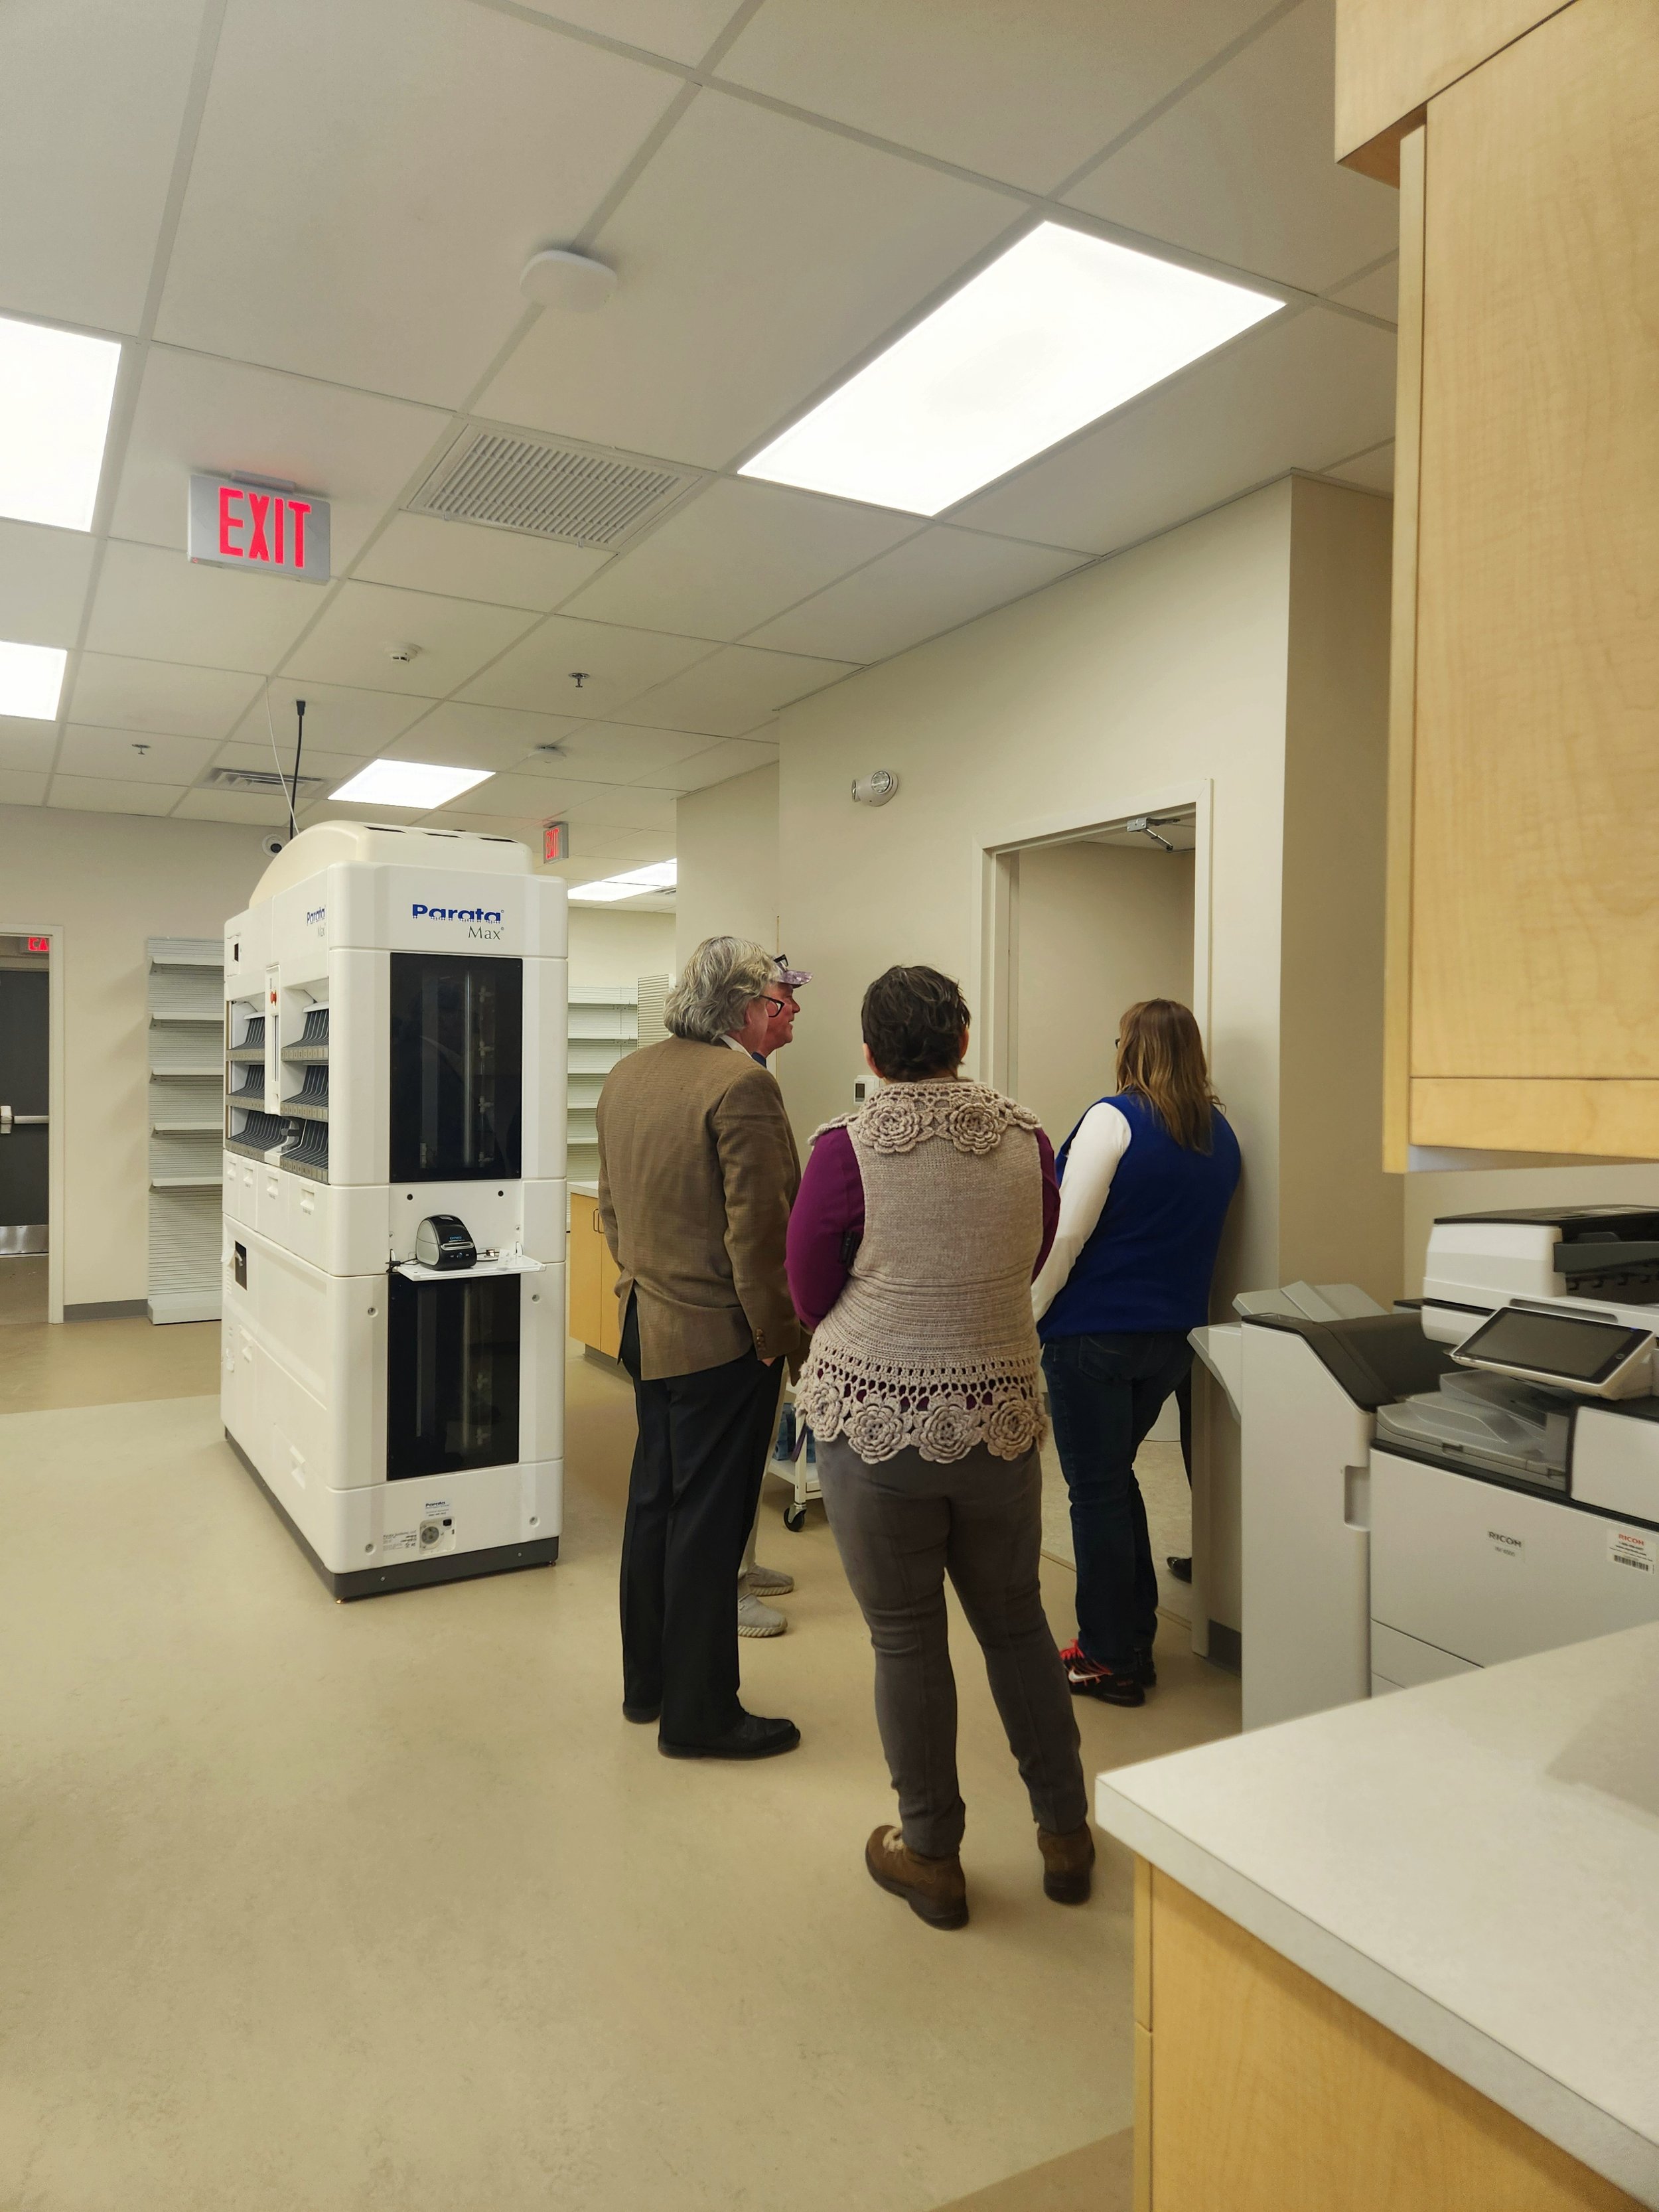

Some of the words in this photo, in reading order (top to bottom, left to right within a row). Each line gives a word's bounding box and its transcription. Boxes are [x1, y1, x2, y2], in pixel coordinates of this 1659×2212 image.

[219, 486, 311, 568] EXIT
[546, 828, 559, 859] EXIT
[307, 907, 326, 926] Parata
[412, 904, 502, 924] Parata
[468, 926, 501, 940] Max
[1488, 1531, 1522, 1548] RICOH
[1619, 1534, 1644, 1546] RICOH
